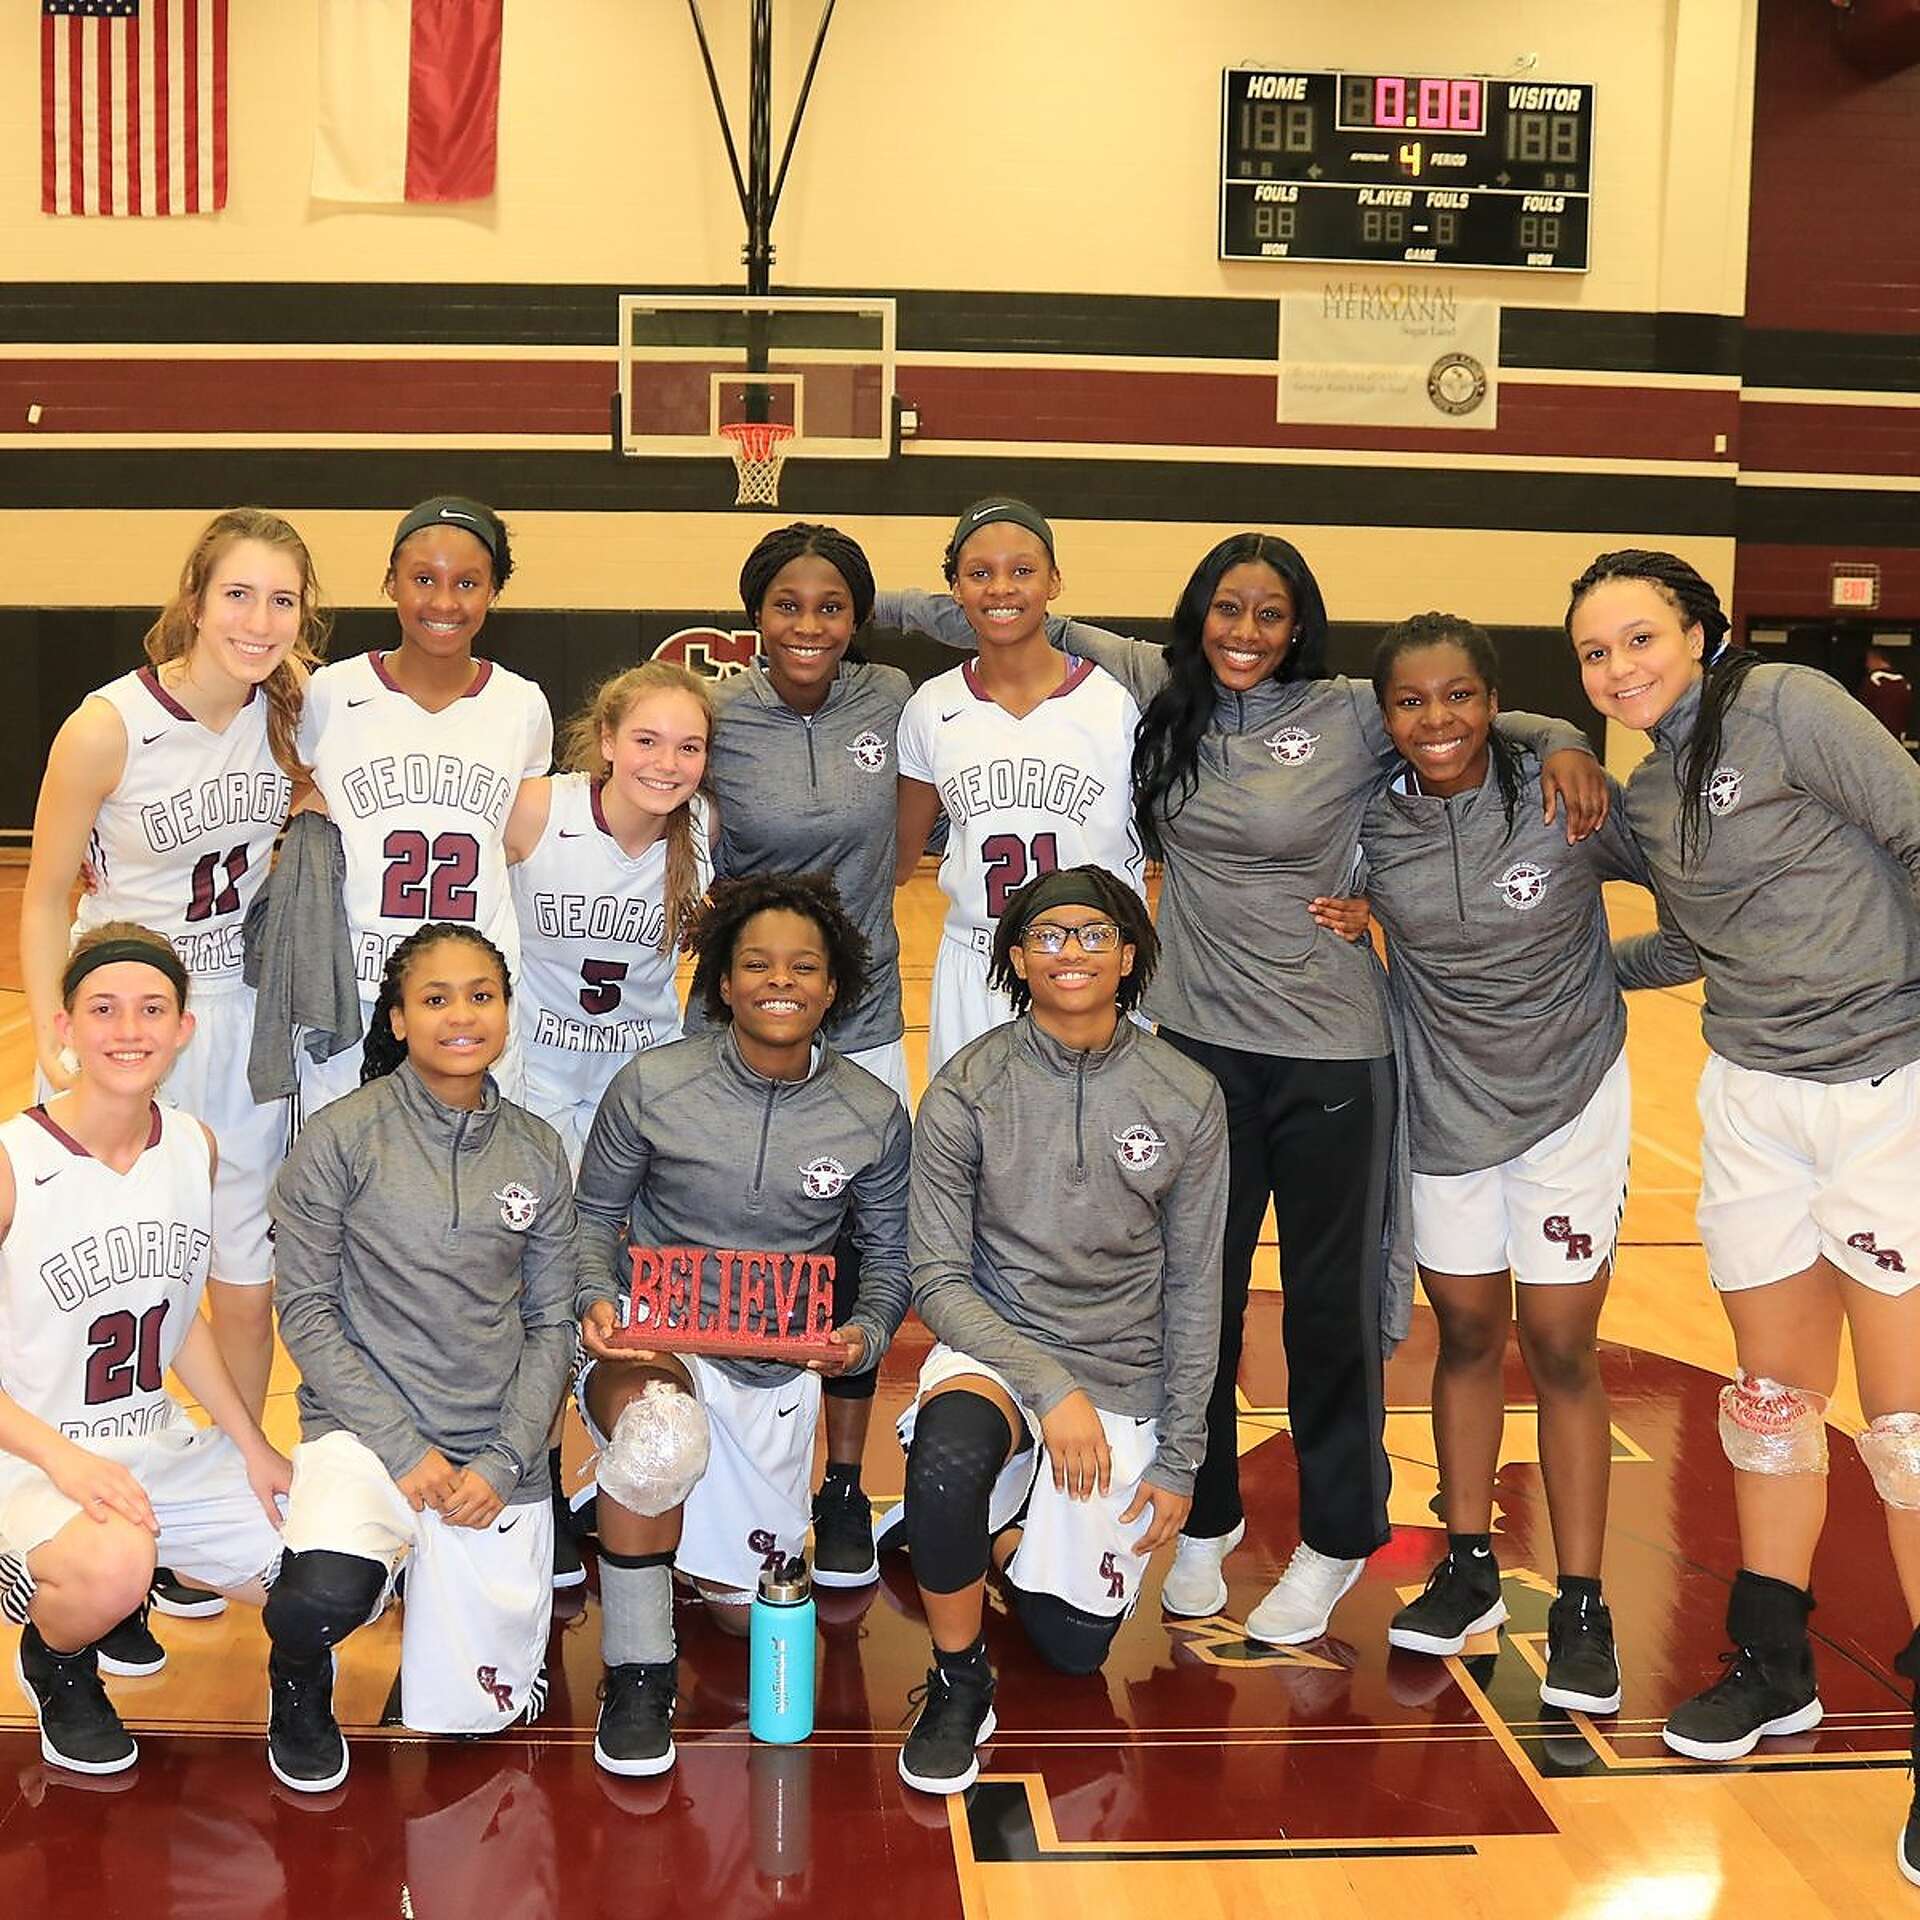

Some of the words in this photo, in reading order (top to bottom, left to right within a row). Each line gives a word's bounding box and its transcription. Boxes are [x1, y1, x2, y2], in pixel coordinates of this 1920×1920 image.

[1246, 75, 1308, 100] HOME
[1508, 86, 1582, 112] VISITOR
[1399, 142, 1421, 177] 4
[1430, 153, 1468, 167] PERIOD
[1254, 185, 1299, 202] FOULS
[1357, 189, 1413, 206] PLAYER
[1426, 192, 1470, 209] FOULS
[1522, 196, 1566, 213] FOULS
[1323, 299, 1457, 321] HERMANN
[141, 772, 293, 853] GEORGE
[341, 754, 511, 829] GEORGE
[941, 757, 1105, 826] GEORGE
[380, 829, 480, 921] 22
[534, 892, 665, 948] GEORG
[578, 958, 629, 1015] 5
[40, 1221, 210, 1312] GEORGE
[627, 1246, 837, 1345] BELIEVE
